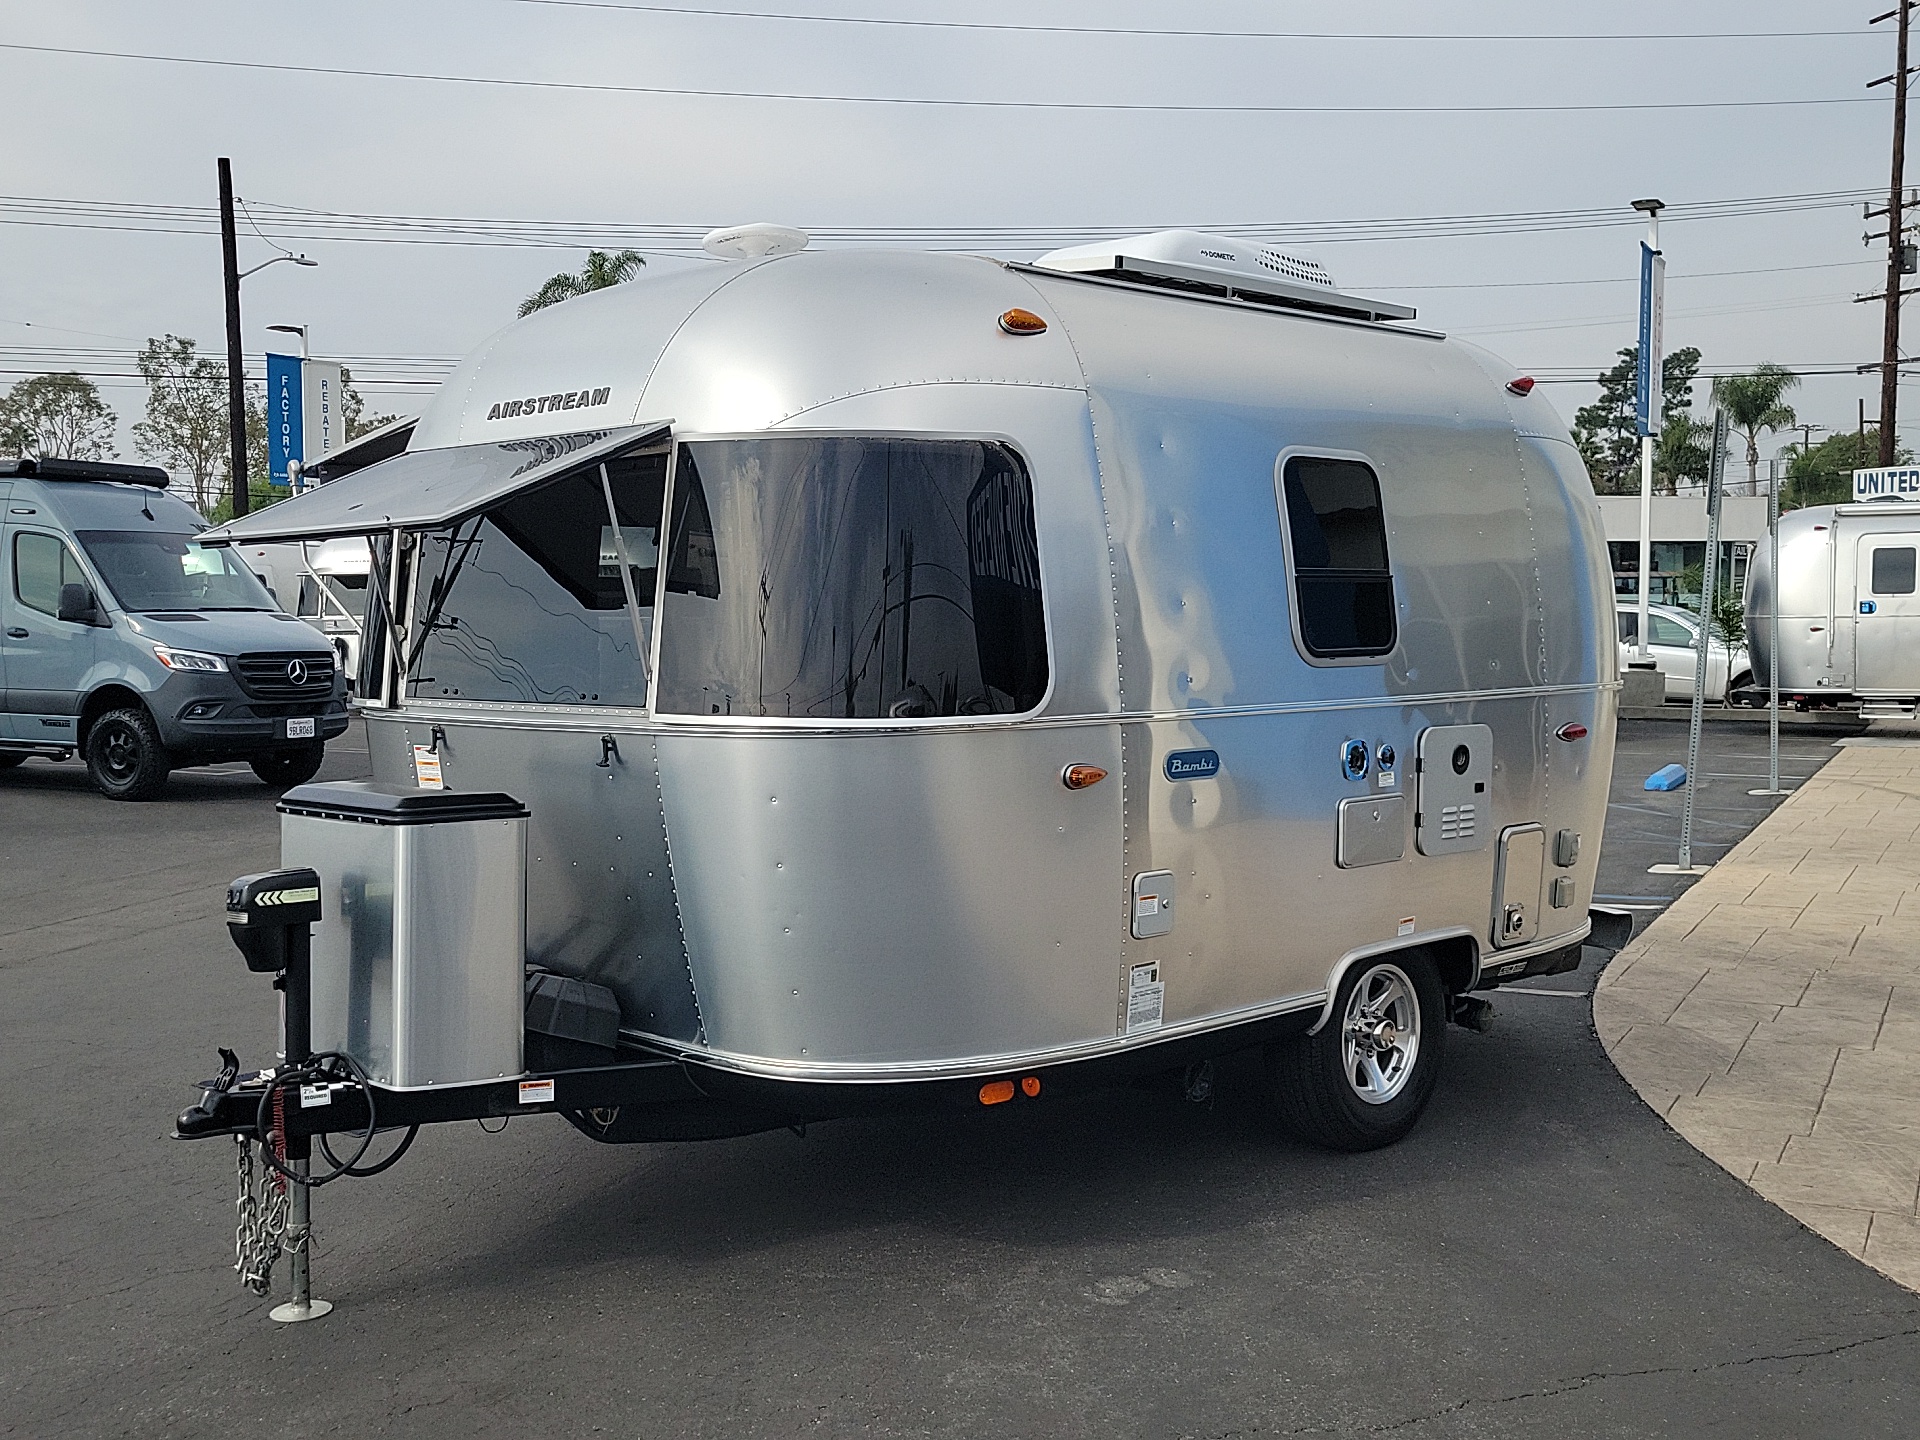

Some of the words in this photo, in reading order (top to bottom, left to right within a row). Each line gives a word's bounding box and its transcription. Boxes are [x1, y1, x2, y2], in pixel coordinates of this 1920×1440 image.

[281, 375, 291, 458] FACTORY
[487, 386, 611, 420] AIRSTREAM
[1857, 470, 1920, 494] UNITED
[1171, 758, 1215, 772] Bambi
